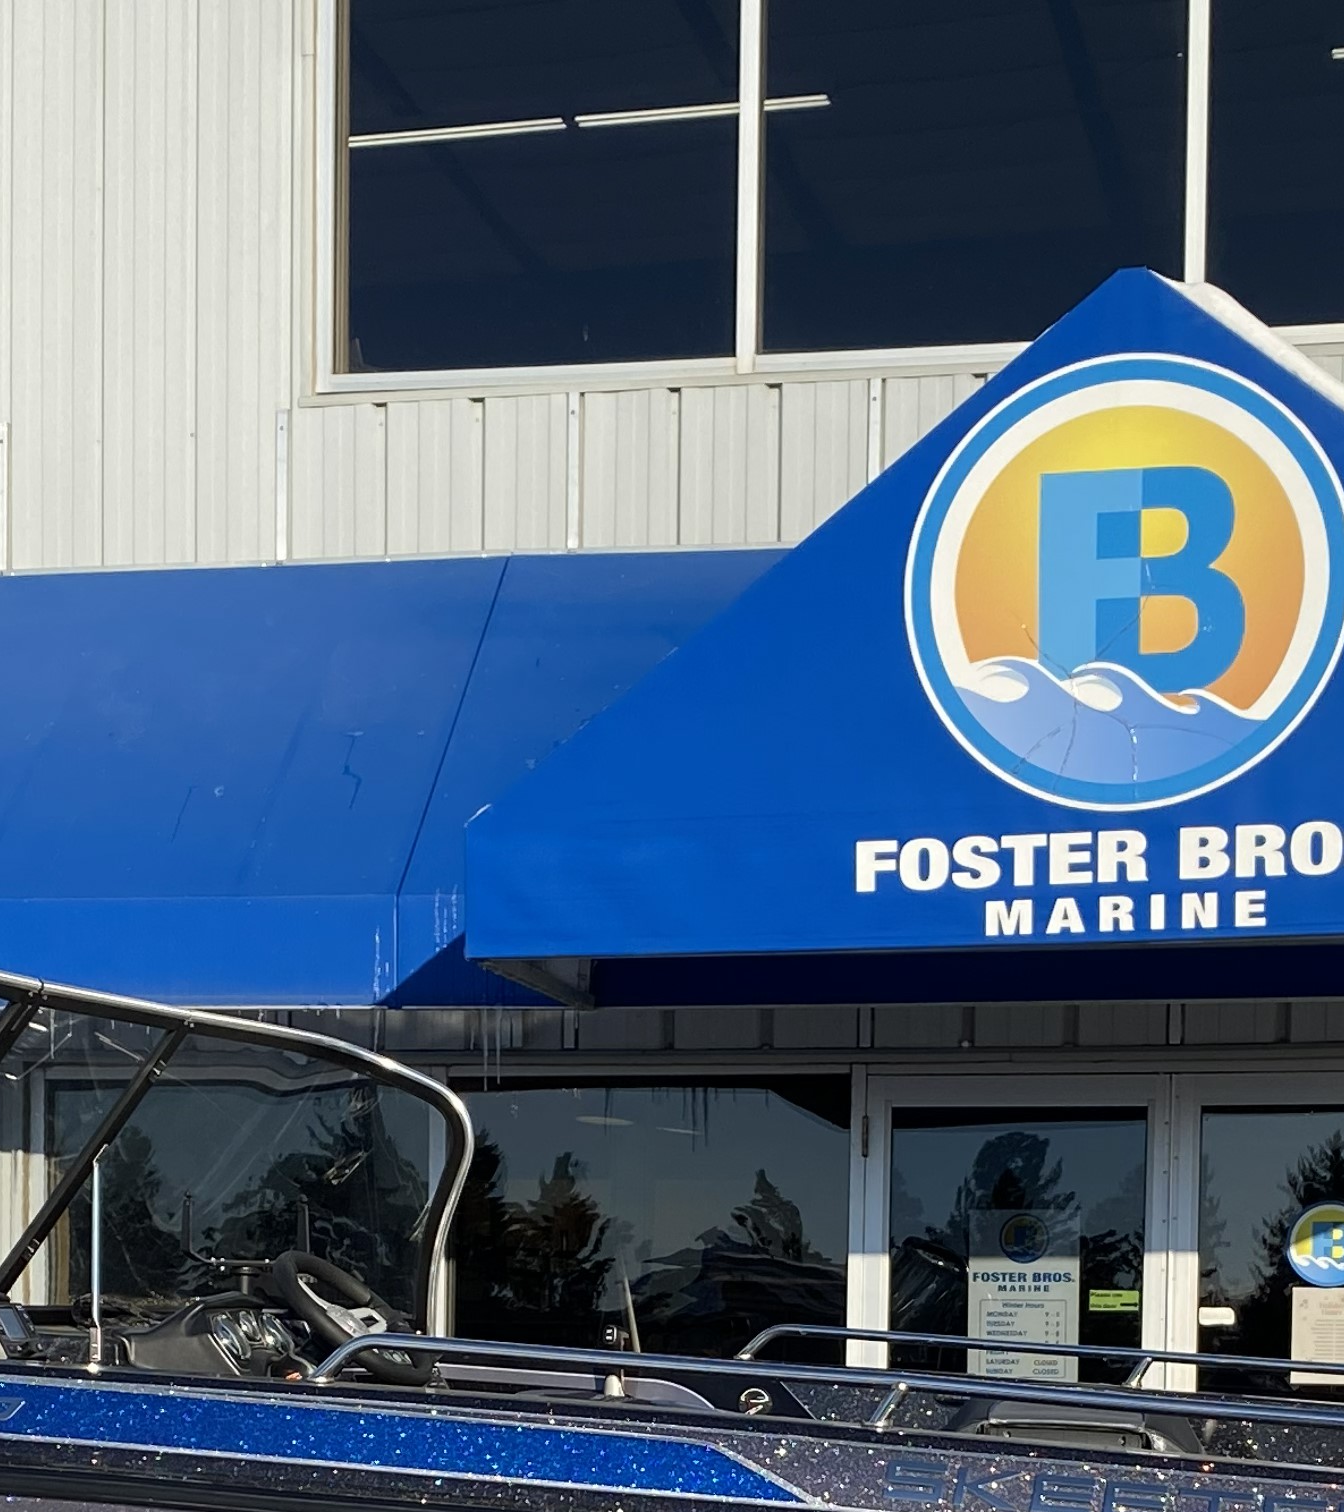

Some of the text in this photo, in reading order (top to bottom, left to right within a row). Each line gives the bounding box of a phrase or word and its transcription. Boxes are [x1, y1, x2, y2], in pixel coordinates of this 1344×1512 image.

[856, 829, 1149, 893] FOSTER
[985, 889, 1267, 936] MARINE
[972, 1271, 1076, 1283] FOSTER BROS.
[997, 1284, 1050, 1292] MARINE
